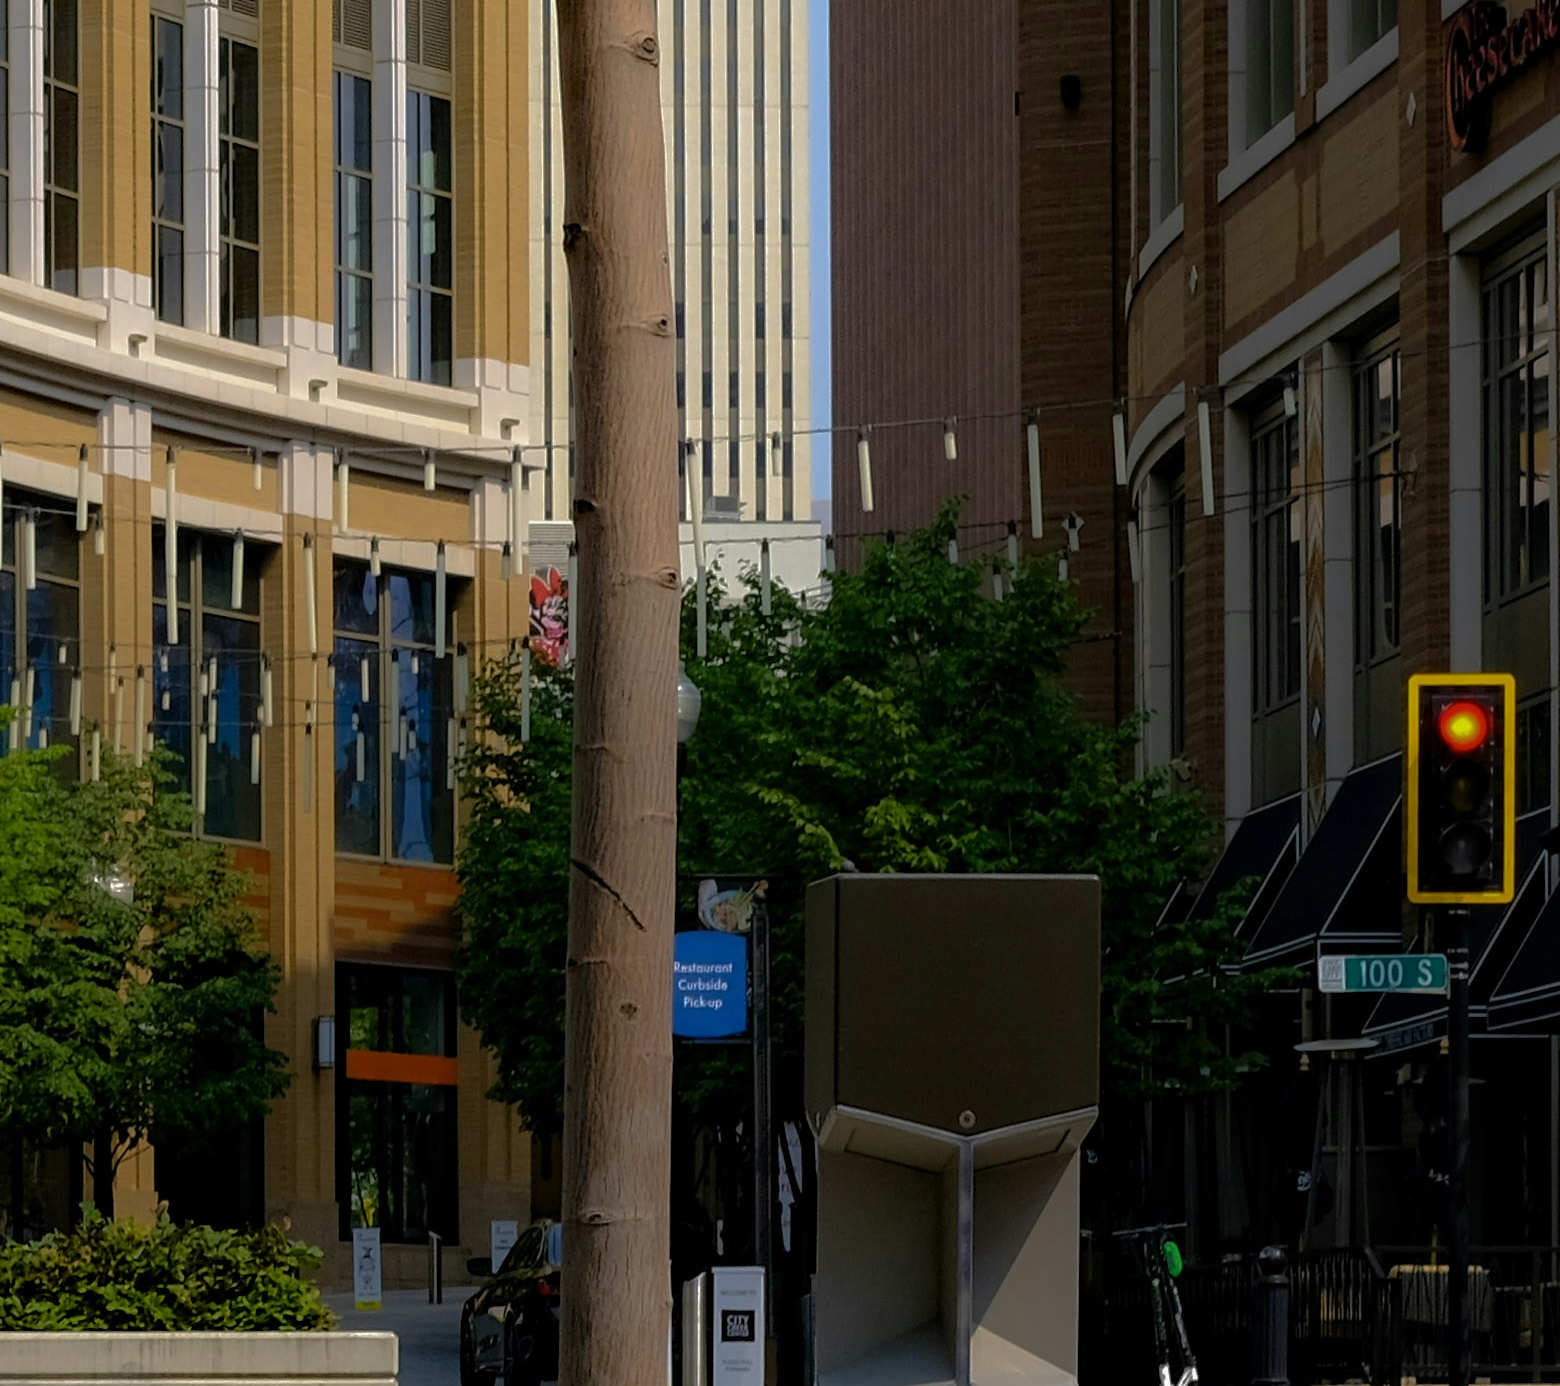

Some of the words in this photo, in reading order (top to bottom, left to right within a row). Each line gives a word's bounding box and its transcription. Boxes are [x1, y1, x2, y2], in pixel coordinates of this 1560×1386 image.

[674, 961, 733, 973] Restaurant
[1359, 959, 1403, 987] 100
[1417, 958, 1433, 986] S
[678, 977, 728, 991] Curbside
[726, 1314, 750, 1325] CITY
